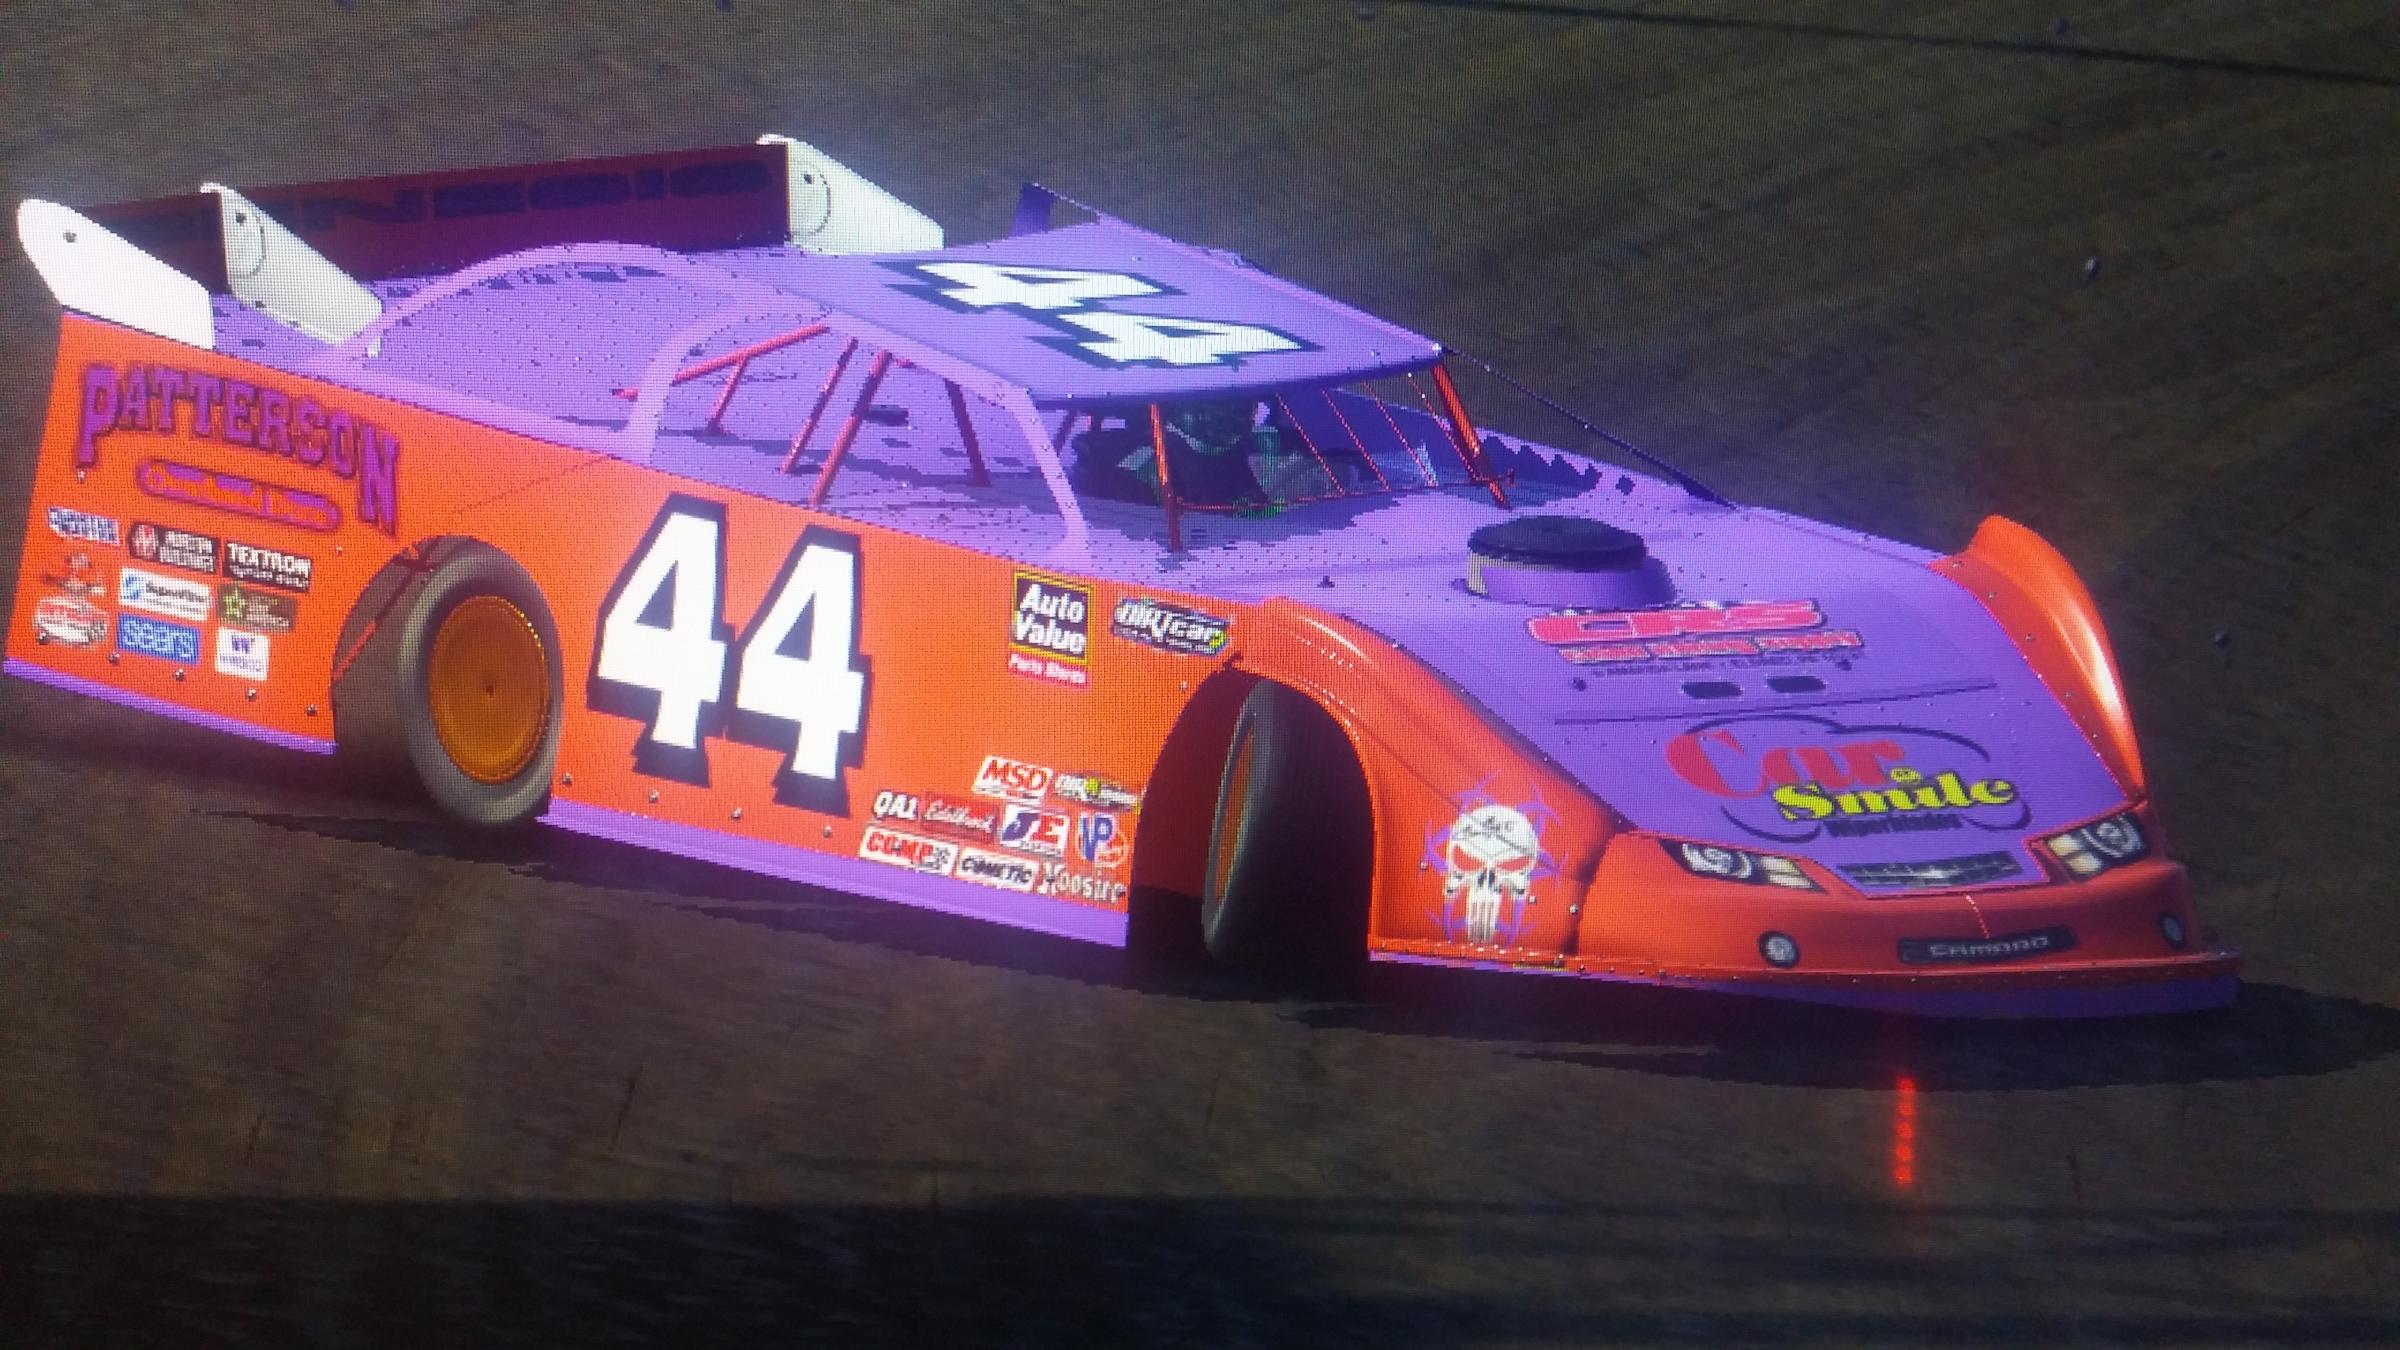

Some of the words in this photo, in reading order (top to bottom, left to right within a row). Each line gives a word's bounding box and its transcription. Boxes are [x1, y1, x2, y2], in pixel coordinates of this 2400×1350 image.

[914, 261, 1304, 365] 44
[75, 361, 400, 537] PATTERSON
[227, 541, 312, 577] TEXTRON
[1019, 582, 1086, 624] Auto
[122, 618, 195, 660] sears
[590, 494, 870, 800] 44
[1015, 611, 1087, 655] Value
[982, 759, 1049, 792] MSD
[1664, 728, 1905, 799] Car
[872, 791, 917, 820] QA1
[1773, 767, 2016, 822] Smile
[865, 828, 934, 864] COMP
[1000, 810, 1066, 844] JE
[1079, 812, 1114, 862] VP
[1927, 933, 2051, 959] CAMARO
